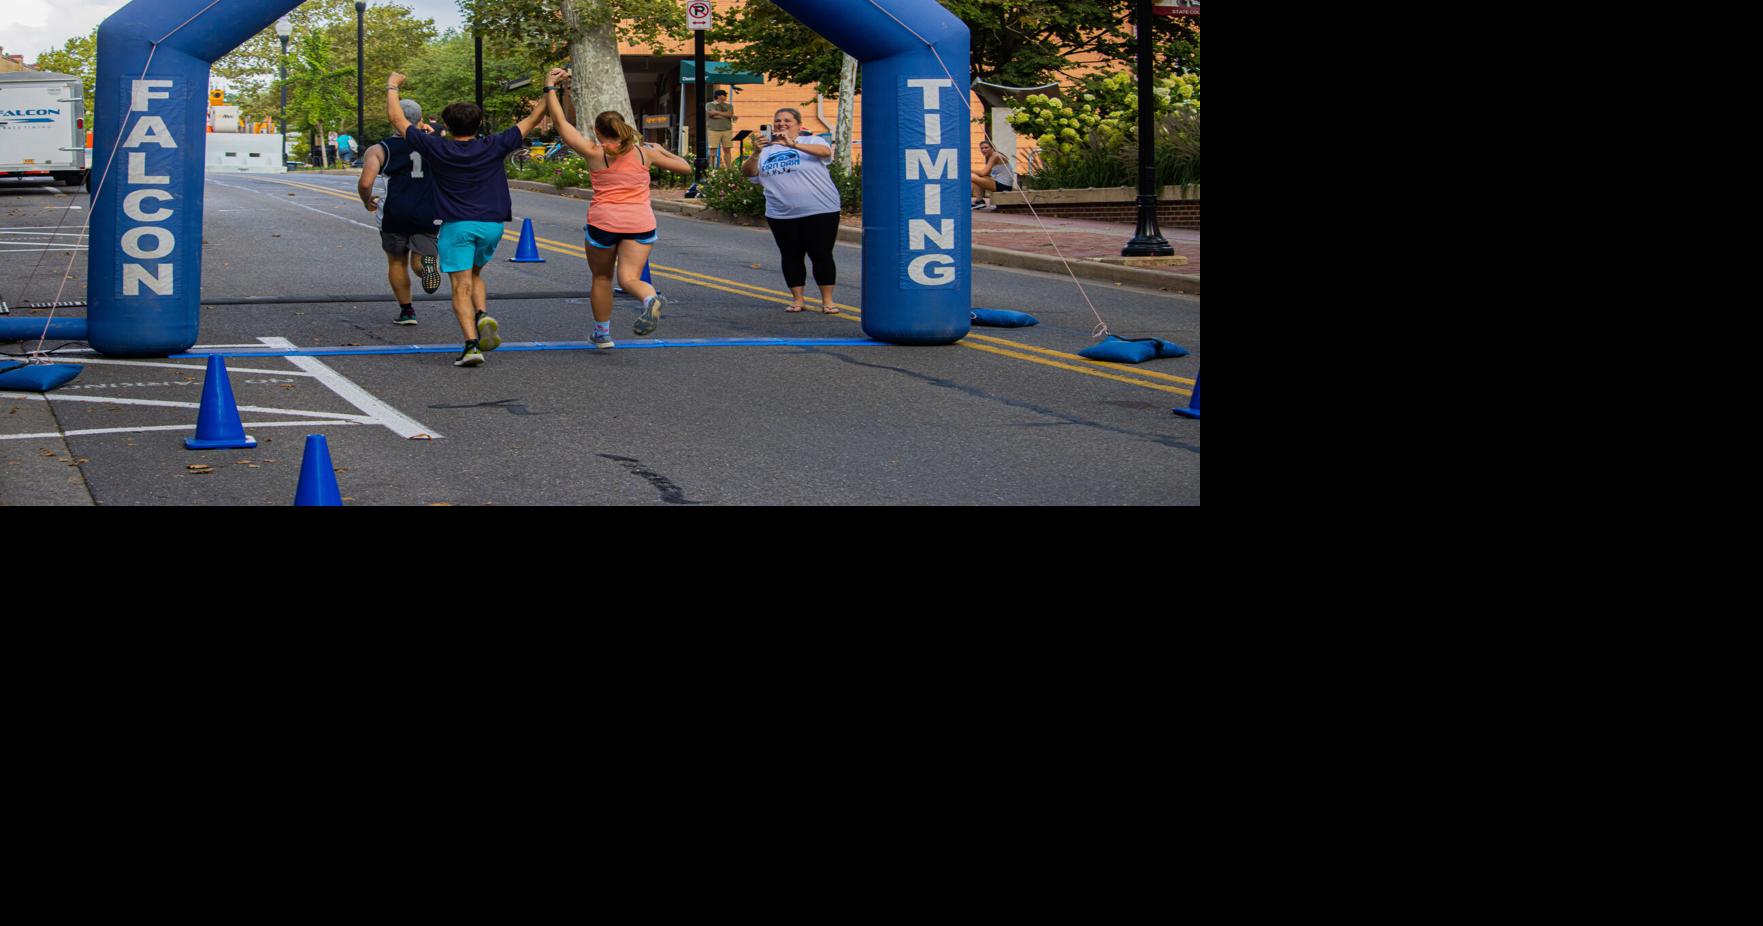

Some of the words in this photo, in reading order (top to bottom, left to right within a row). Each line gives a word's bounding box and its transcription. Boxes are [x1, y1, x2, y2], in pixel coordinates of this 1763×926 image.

[120, 79, 178, 296] FALCON
[409, 150, 424, 178] 1
[904, 78, 959, 286] TIMING
